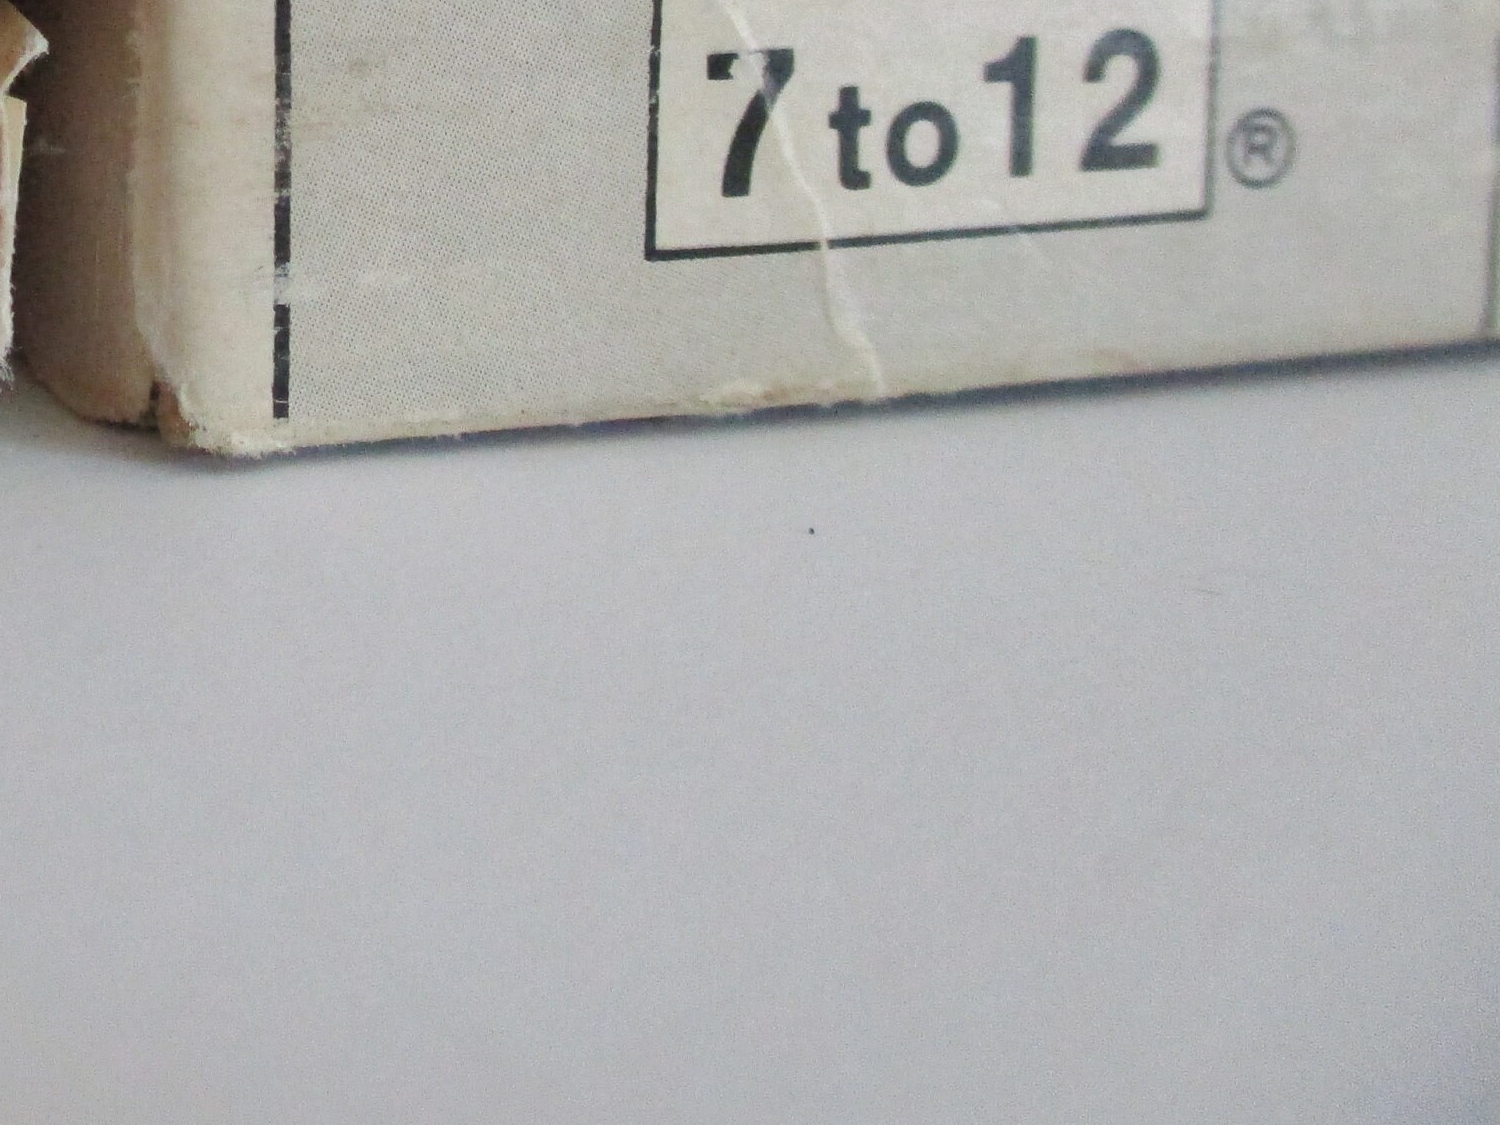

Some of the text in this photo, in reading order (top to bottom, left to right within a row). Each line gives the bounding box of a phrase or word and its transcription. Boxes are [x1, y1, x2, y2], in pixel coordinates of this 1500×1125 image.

[706, 28, 1161, 198] 7 to 12
